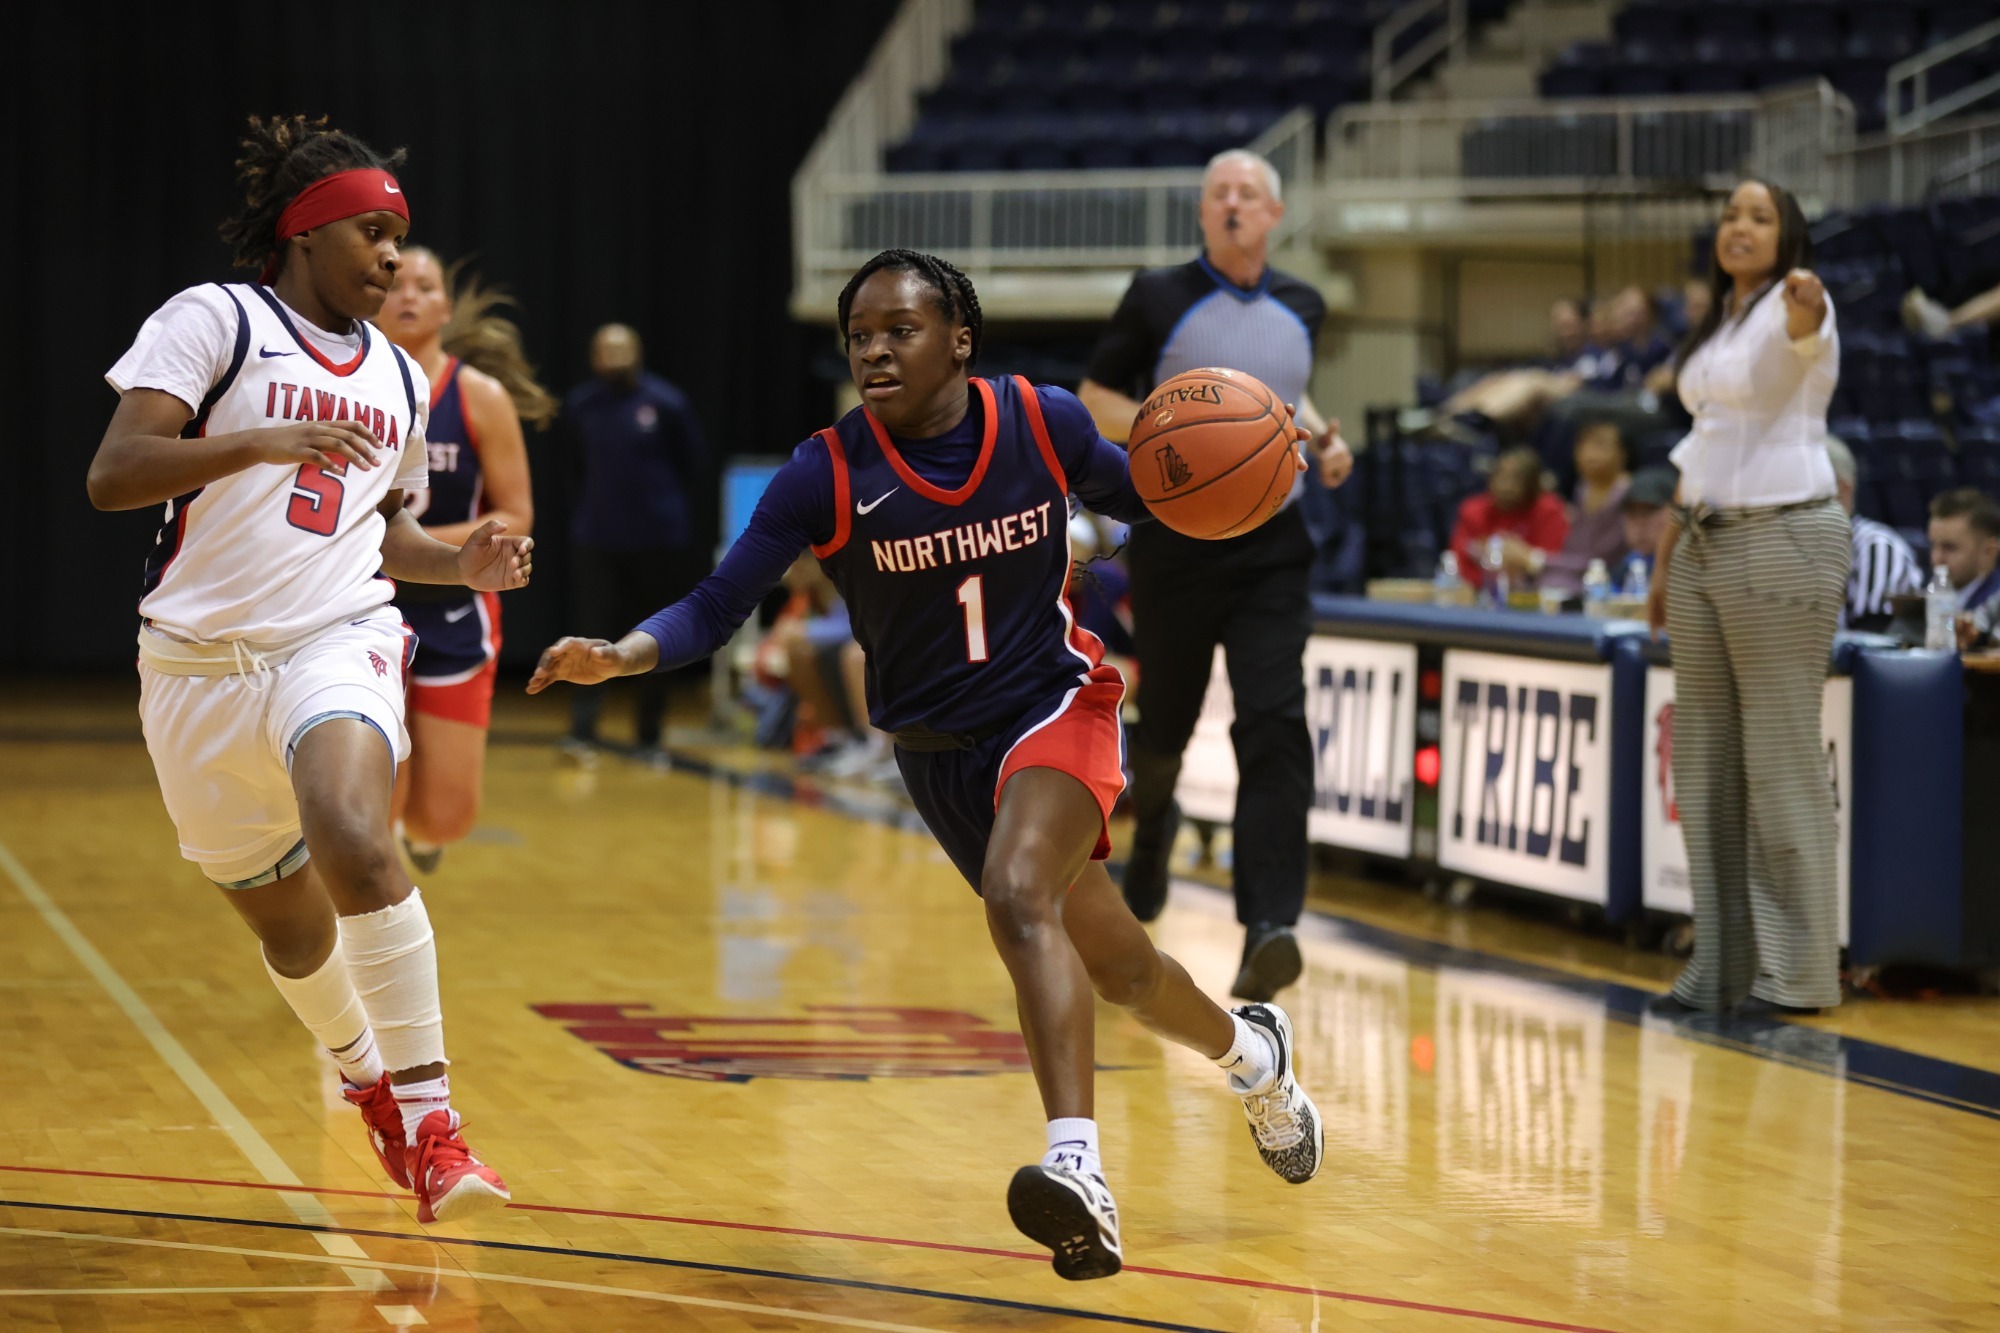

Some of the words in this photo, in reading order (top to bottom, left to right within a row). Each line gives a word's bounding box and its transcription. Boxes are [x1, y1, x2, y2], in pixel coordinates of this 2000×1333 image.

[265, 382, 398, 451] ITAWAMBA
[286, 452, 349, 537] 5
[871, 501, 1051, 572] NORTHWEST
[955, 574, 989, 663] 1
[1453, 679, 1597, 868] TRIBE
